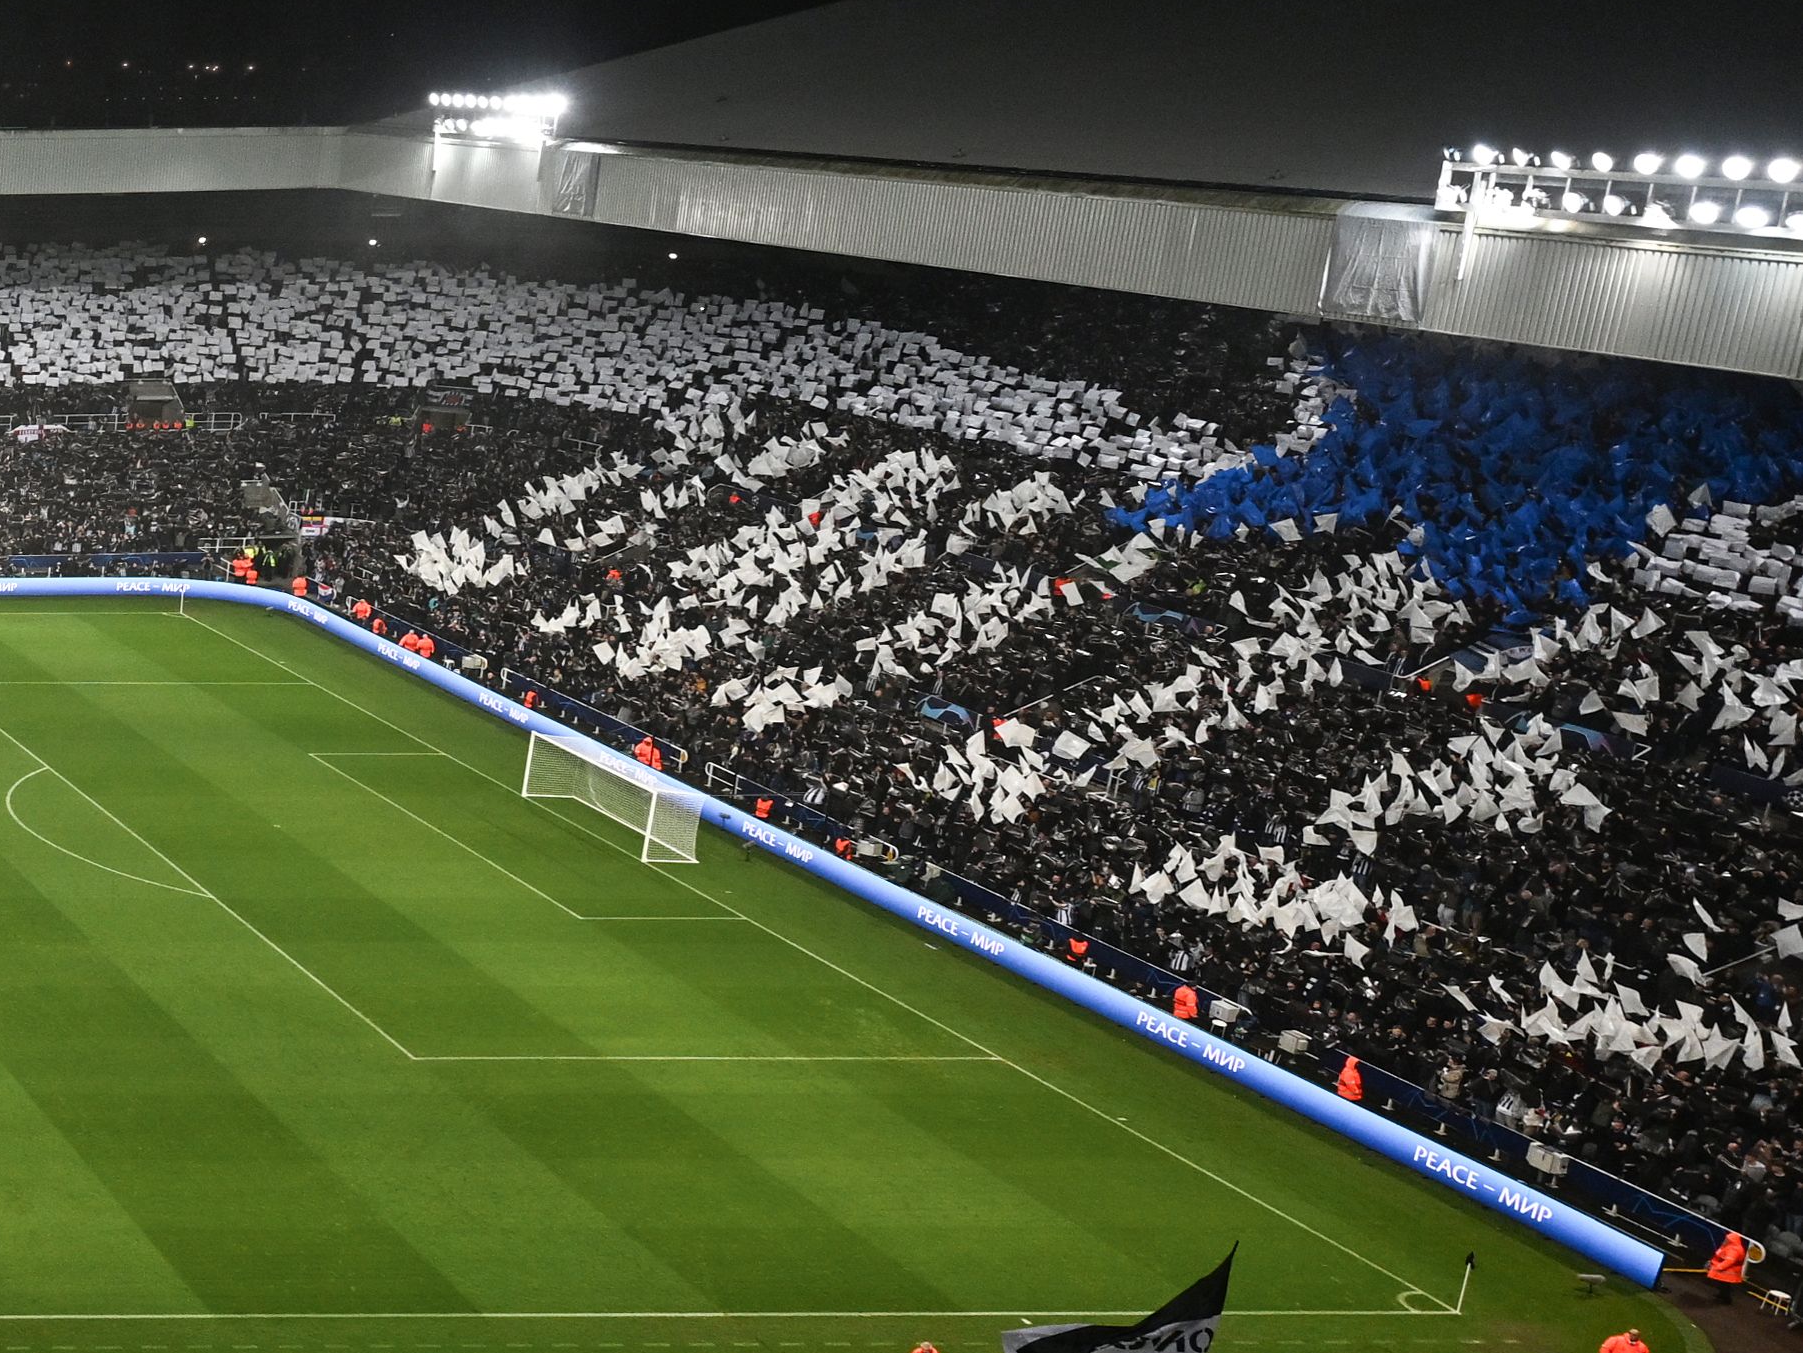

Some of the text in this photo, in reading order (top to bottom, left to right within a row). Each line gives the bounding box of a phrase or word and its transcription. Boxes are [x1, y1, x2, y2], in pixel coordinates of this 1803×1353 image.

[116, 581, 151, 592] PEACE
[287, 600, 309, 616] PEACE
[377, 643, 400, 661] PEACE
[478, 692, 503, 713] PEACE
[917, 905, 1005, 955] PEACE МИР
[1136, 1011, 1246, 1073] PEACE МИР
[1413, 1145, 1553, 1223] PEACE МИР
